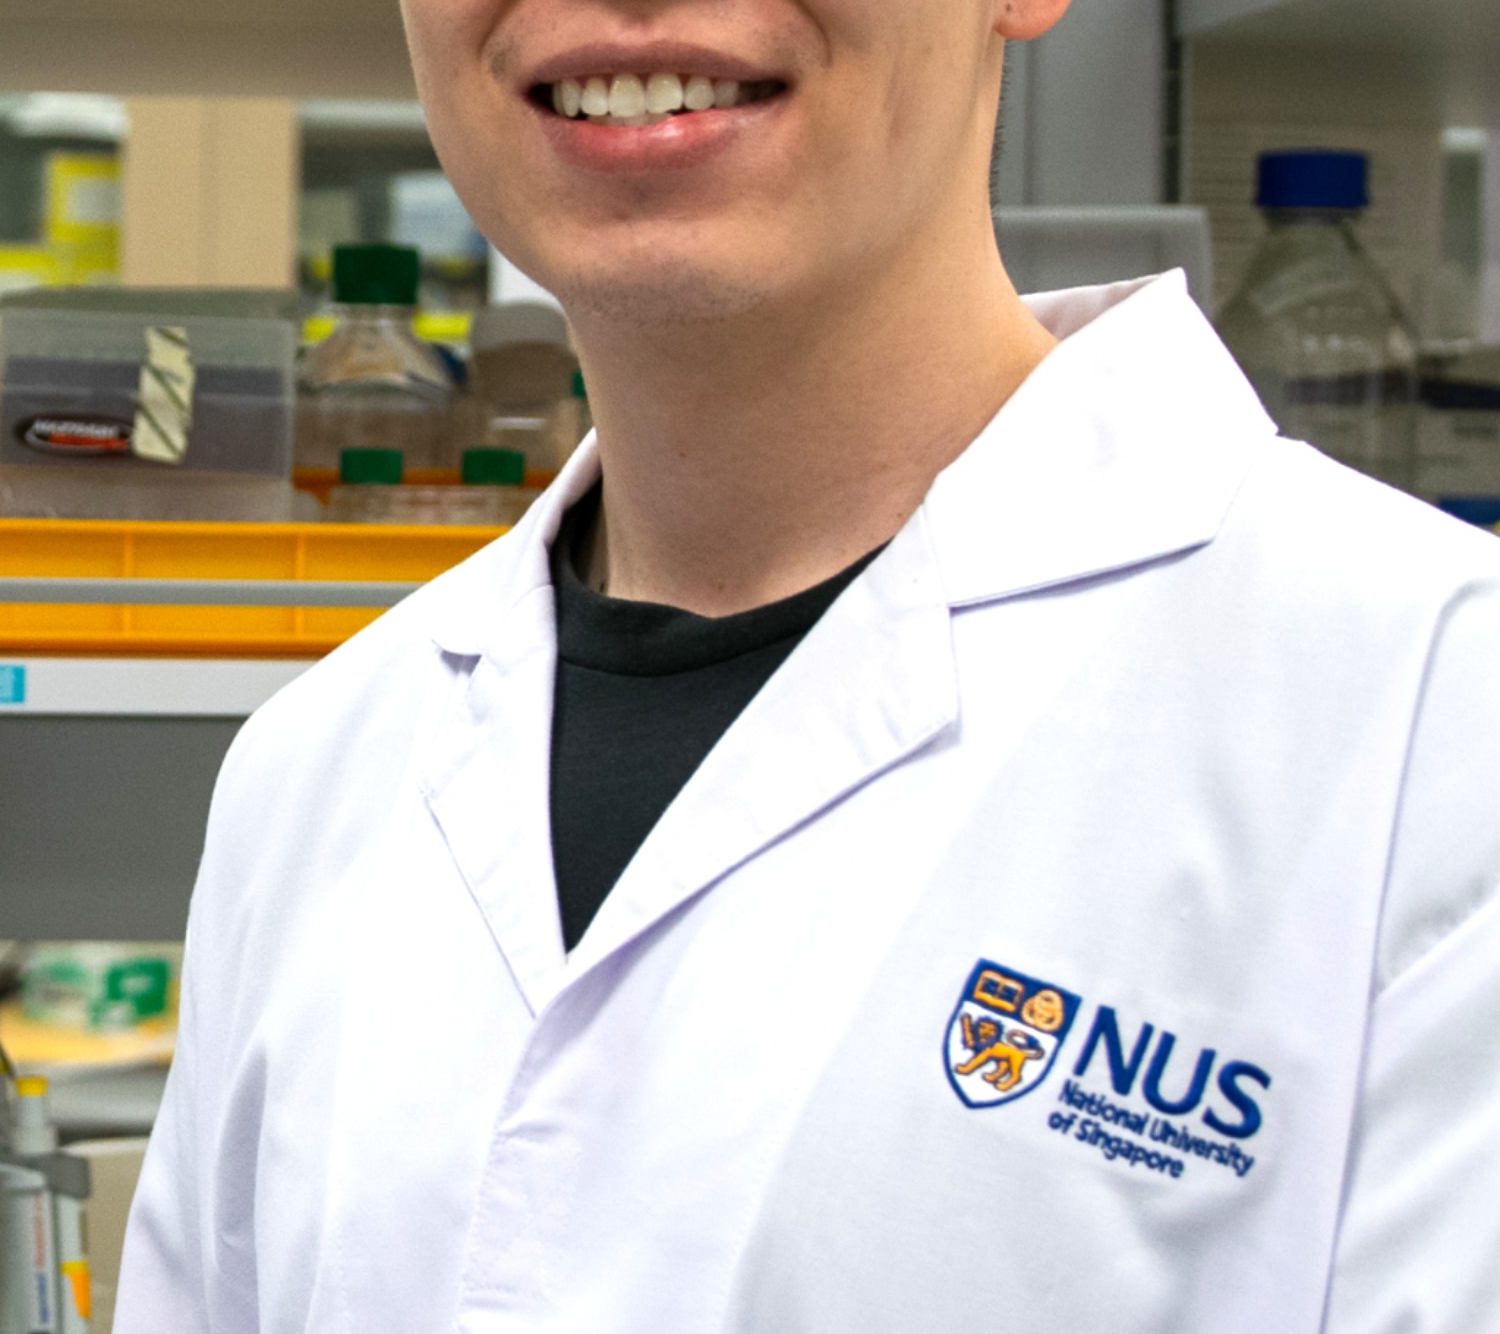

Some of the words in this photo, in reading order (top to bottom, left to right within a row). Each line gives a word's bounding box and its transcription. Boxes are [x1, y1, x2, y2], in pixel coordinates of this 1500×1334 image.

[1072, 1003, 1272, 1140] NUS
[1047, 1112, 1077, 1135] of
[1073, 1117, 1186, 1179] Singapore
[1057, 1078, 1150, 1136] National
[1149, 1116, 1256, 1178] University
